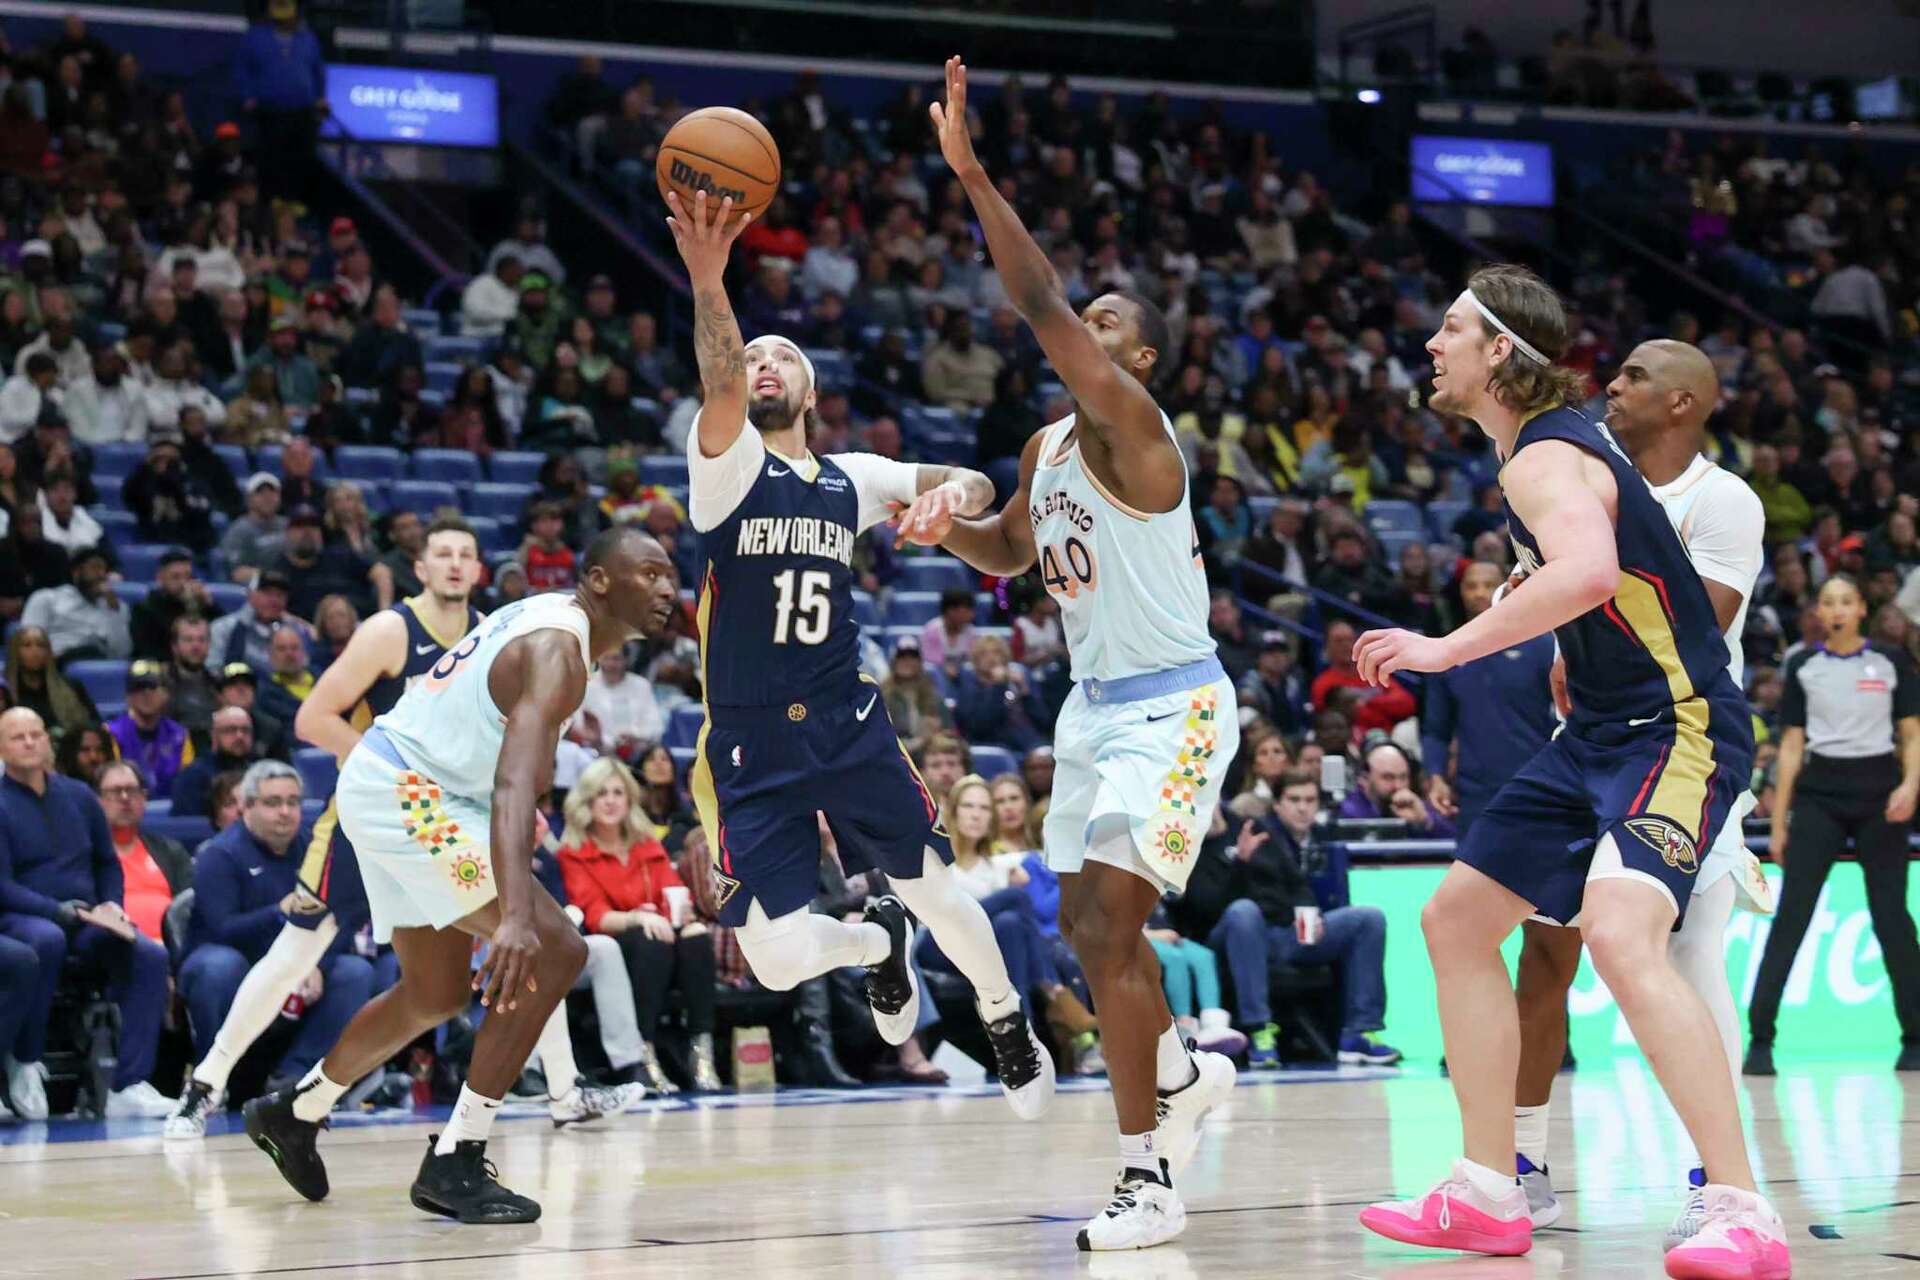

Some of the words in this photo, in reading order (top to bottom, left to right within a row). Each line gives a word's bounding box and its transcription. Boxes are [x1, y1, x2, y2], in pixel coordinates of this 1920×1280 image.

[737, 517, 792, 556] NEW
[1043, 536, 1092, 592] 40
[773, 569, 831, 645] 15
